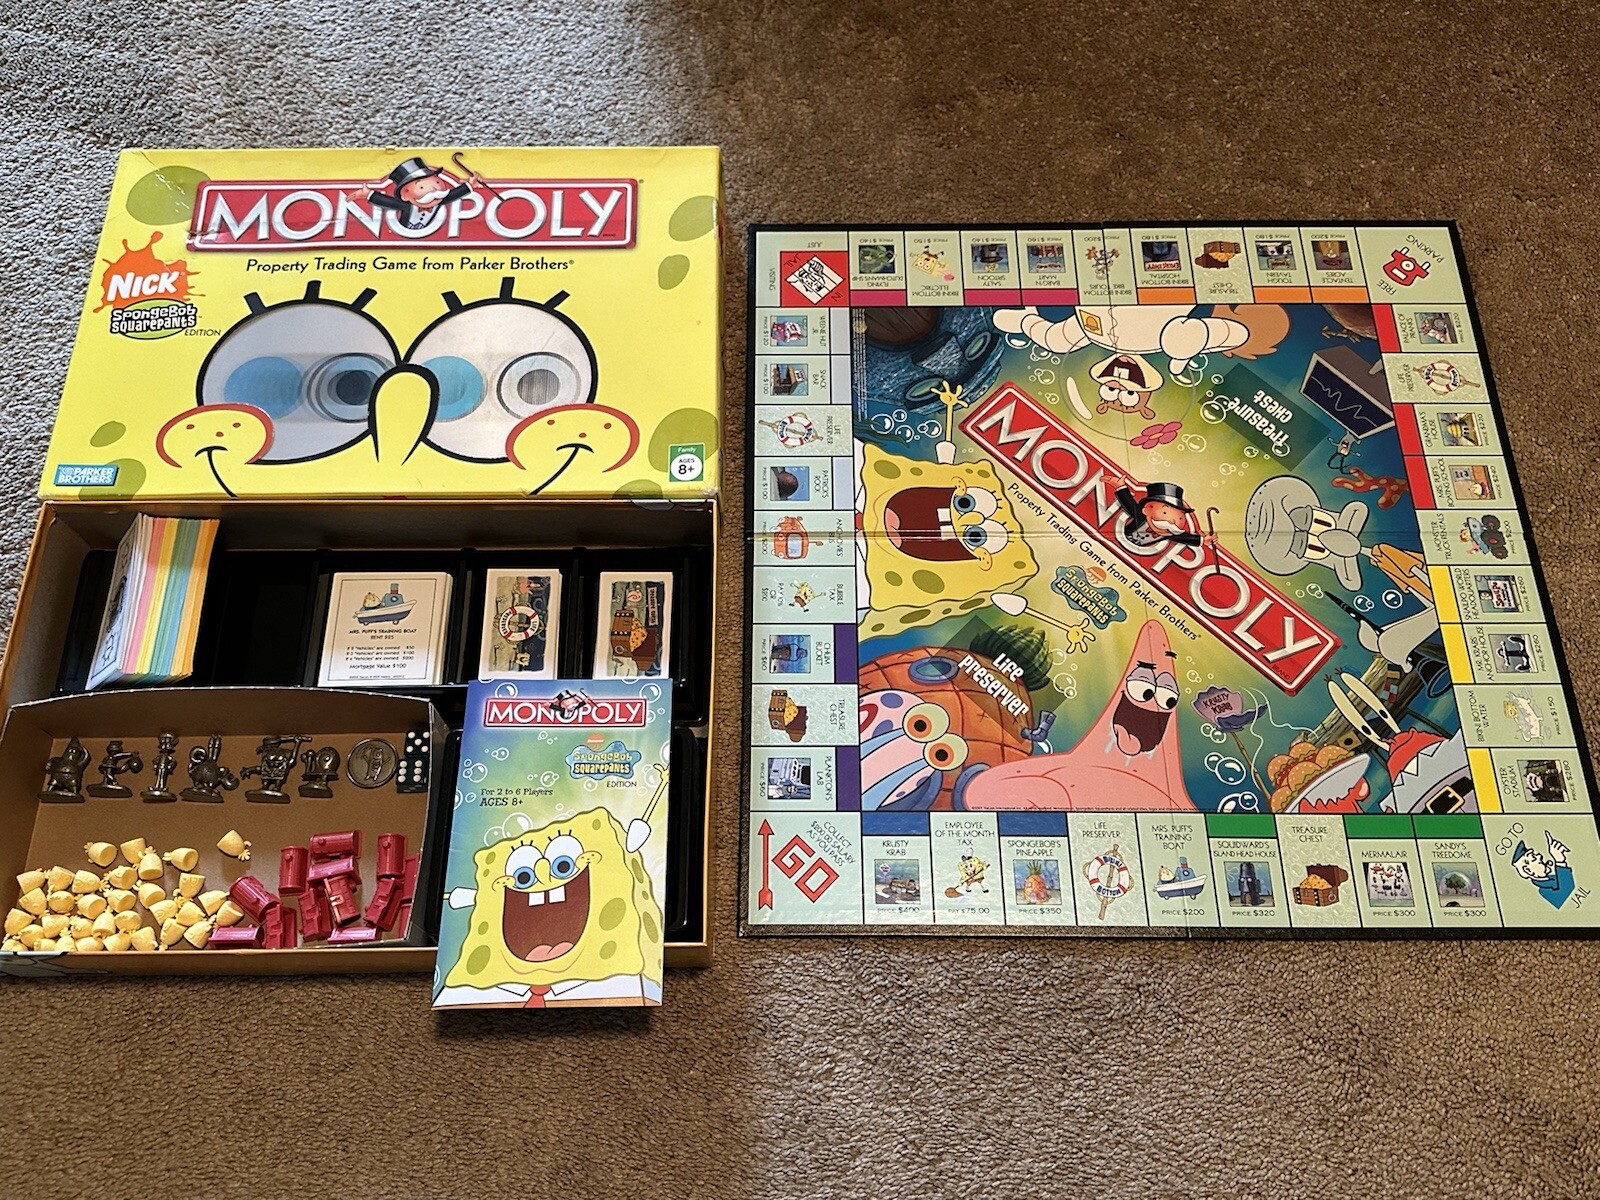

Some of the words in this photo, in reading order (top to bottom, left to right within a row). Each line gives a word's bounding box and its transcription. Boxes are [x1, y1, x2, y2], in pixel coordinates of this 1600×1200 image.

[202, 189, 623, 241] MONOPOLY
[1405, 234, 1445, 263] PARKING
[246, 258, 309, 274] Property
[314, 257, 366, 272] Trading
[372, 257, 417, 270] Game
[422, 257, 454, 270] from
[460, 257, 504, 270] Parker
[783, 253, 801, 268] JAIL
[106, 271, 180, 302] NICK
[768, 267, 776, 291] VISITING
[1376, 279, 1397, 295] FREE
[1400, 320, 1409, 344] PALACE
[1428, 419, 1438, 440] HOUSE
[58, 475, 112, 484] BROTHERS
[74, 467, 114, 476] PARKER
[678, 464, 695, 475] 8+
[977, 400, 1322, 663] MONOPOLY
[1431, 521, 1443, 551] MONSTER
[1437, 513, 1448, 540] RENTALS
[1442, 538, 1452, 560] TRUCK
[1007, 482, 1045, 517] Property
[1046, 513, 1077, 545] Trading
[1079, 540, 1106, 567] Game
[1106, 563, 1128, 585] from
[1129, 580, 1158, 609] Parker
[1158, 605, 1197, 641] Brothers
[1454, 568, 1465, 591] WORLD
[770, 589, 776, 599] OR
[1464, 569, 1480, 620] HEADQUARTERS
[1477, 625, 1487, 648] HOUSE
[992, 652, 1024, 682] Life
[1483, 649, 1495, 681] ANCHOR
[1202, 693, 1229, 708] KRUSTY
[1211, 702, 1233, 715] KRAB
[1467, 690, 1480, 722] BOTTOM
[489, 702, 642, 724] MONOPOLY
[838, 699, 846, 730] TREASURE
[1479, 703, 1490, 728] WATER
[1475, 722, 1485, 742] BIKINI
[1499, 767, 1511, 795] OYSTER
[1508, 765, 1521, 798] STADIUM
[479, 798, 508, 806] AGES
[511, 798, 523, 806] 8+
[523, 788, 553, 797] Players
[823, 821, 852, 848] COLLECT
[1082, 830, 1121, 838] PRESERVER
[1154, 833, 1192, 841] TRAINING
[1291, 826, 1328, 834] TREASURE
[1495, 837, 1513, 856] GO
[1507, 822, 1524, 839] TO
[806, 829, 817, 839] AS
[815, 838, 831, 854] YOU
[829, 851, 846, 867] PASS
[831, 841, 856, 864] SALARY
[882, 840, 909, 848] KRUSTY
[886, 848, 906, 856] KRAB
[1007, 840, 1061, 848] SPONGEBOB'S
[1163, 842, 1185, 850] BOAT
[1218, 841, 1270, 849] SQUIDWARD'S
[1432, 851, 1472, 859] TREEDOME
[1434, 842, 1467, 850] SANDY'S
[771, 834, 840, 904] GO
[1097, 885, 1121, 896] BOTTOM
[1571, 886, 1592, 909] JAIL
[1039, 907, 1062, 915] $350
